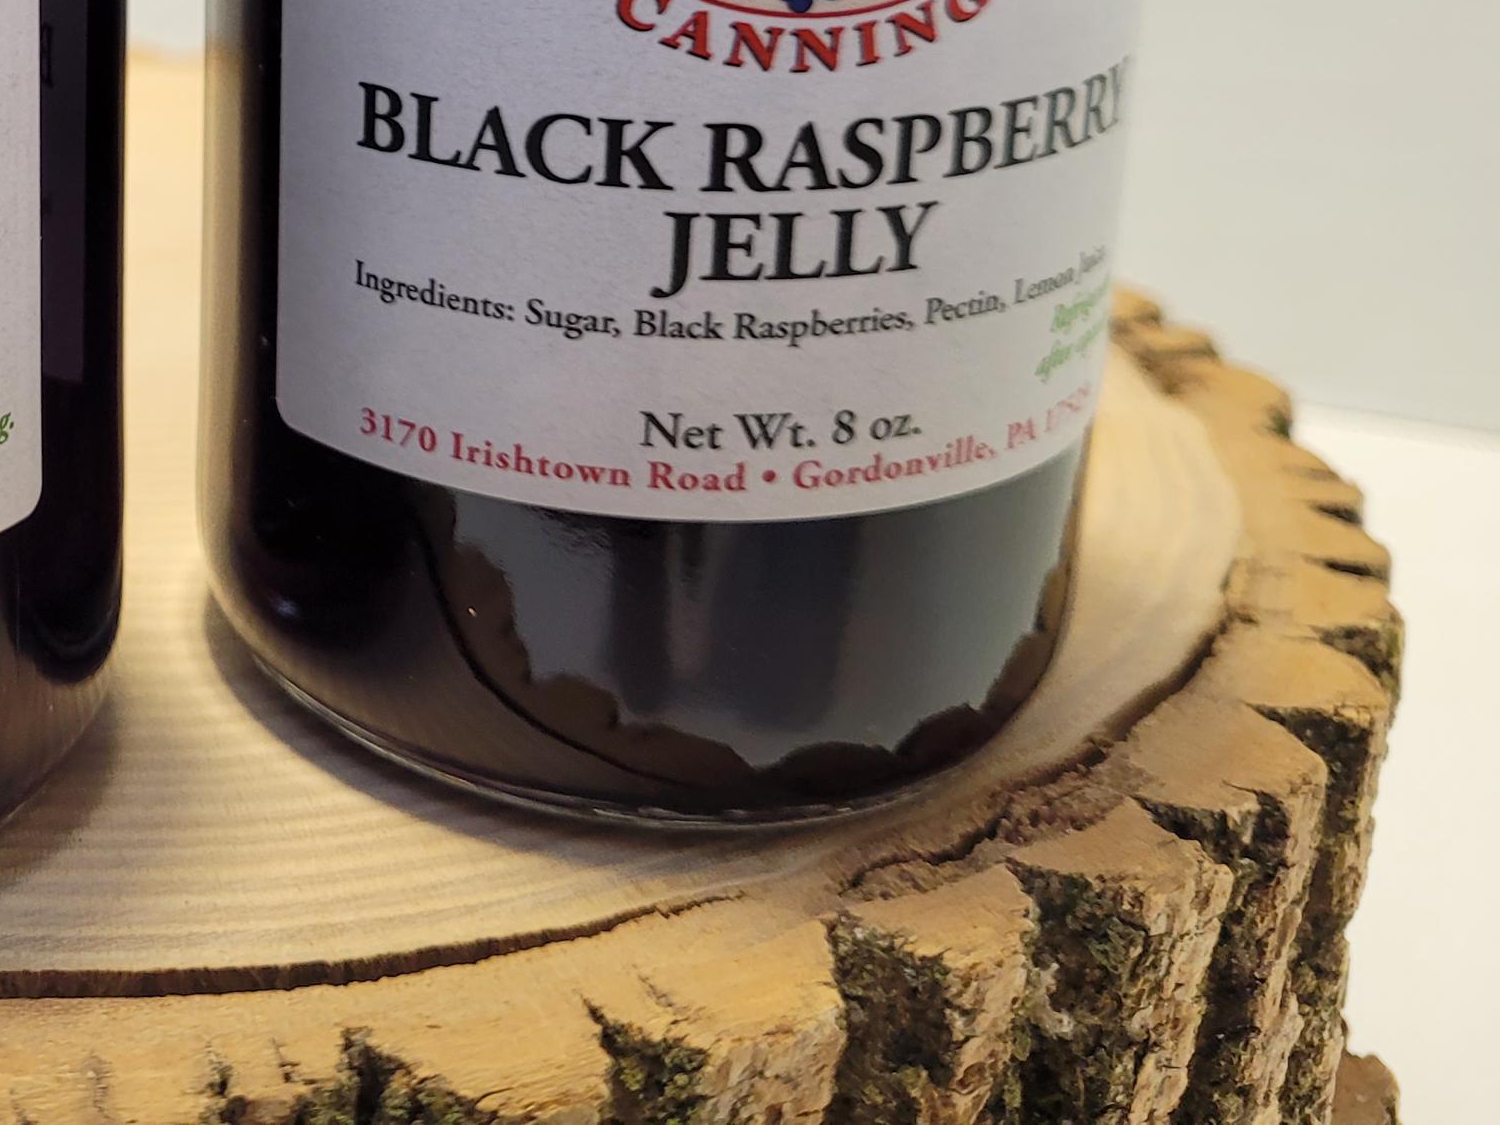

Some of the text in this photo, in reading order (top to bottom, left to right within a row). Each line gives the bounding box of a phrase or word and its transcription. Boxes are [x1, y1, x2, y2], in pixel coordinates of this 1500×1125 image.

[357, 81, 674, 191] BLACK
[651, 200, 940, 299] JELLY
[353, 260, 517, 321] Ingredients:
[524, 298, 620, 340] Sugar,
[632, 307, 725, 342] Black
[732, 302, 915, 350] Raspberries,
[924, 290, 1008, 325] Pectin,
[359, 406, 439, 453] 3170
[450, 431, 632, 488] Irishtown
[648, 461, 747, 493] Road
[792, 435, 997, 492] Gordonville,
[639, 410, 923, 450] Net Wt. 8 oz.
